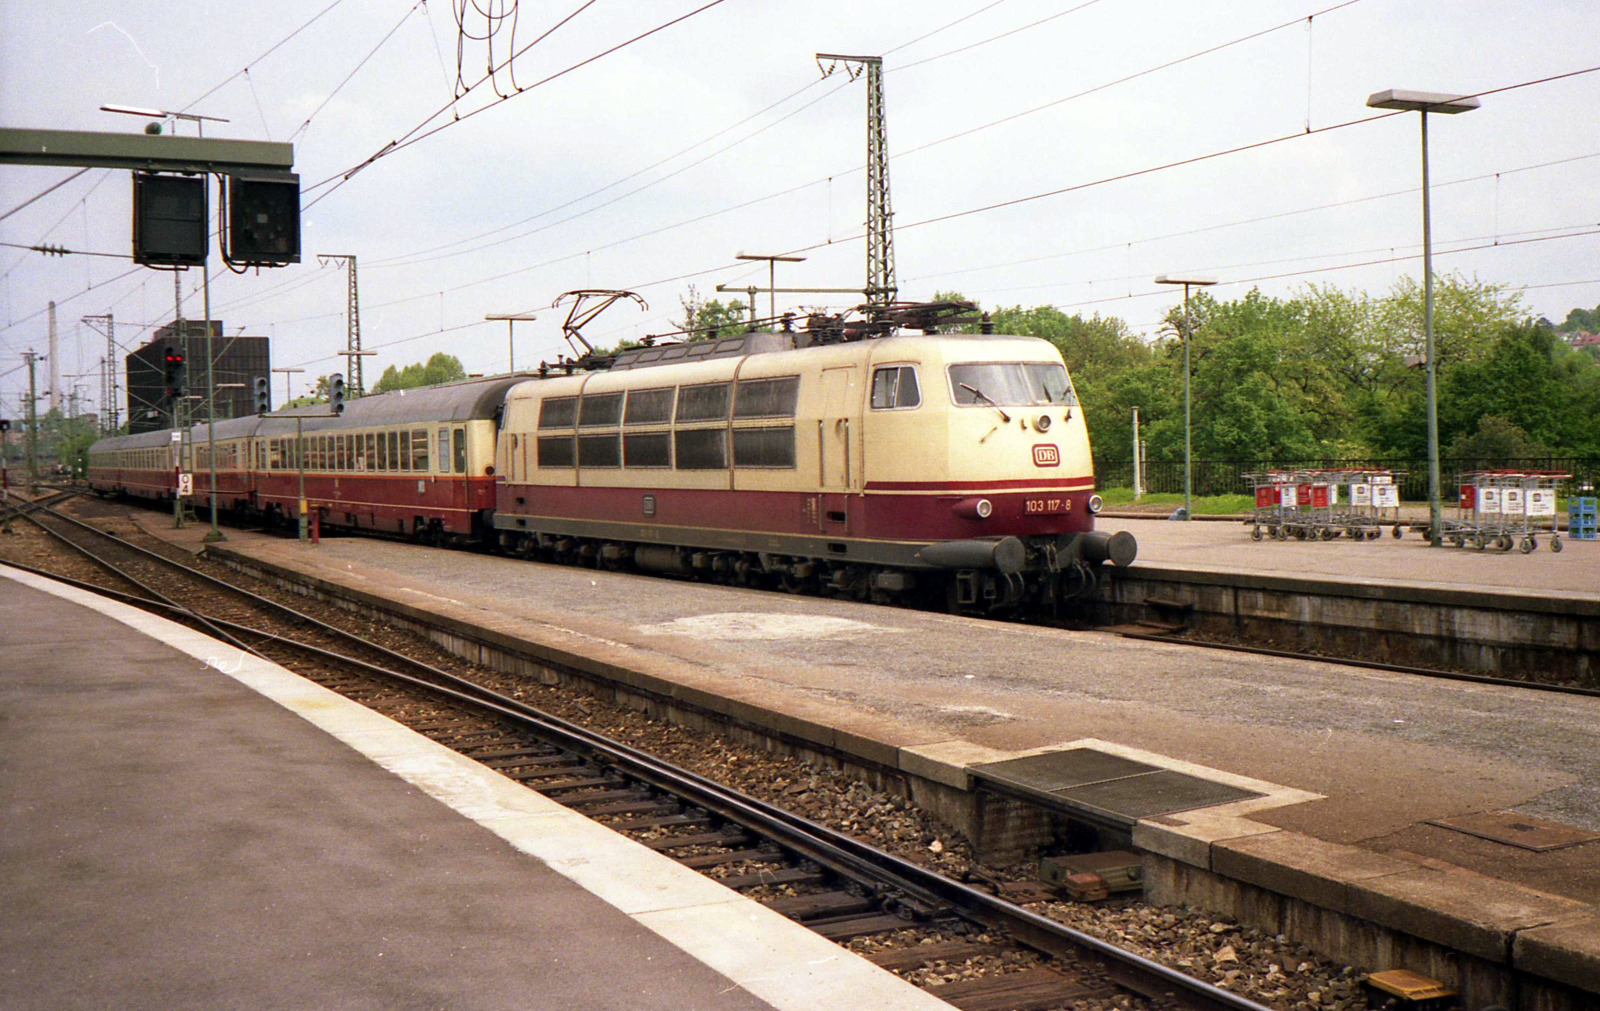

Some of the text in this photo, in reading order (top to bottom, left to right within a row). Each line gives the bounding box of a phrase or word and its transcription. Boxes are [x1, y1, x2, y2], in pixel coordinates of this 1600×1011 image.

[1038, 450, 1055, 461] DB
[182, 485, 189, 493] 4
[1026, 500, 1044, 512] 103
